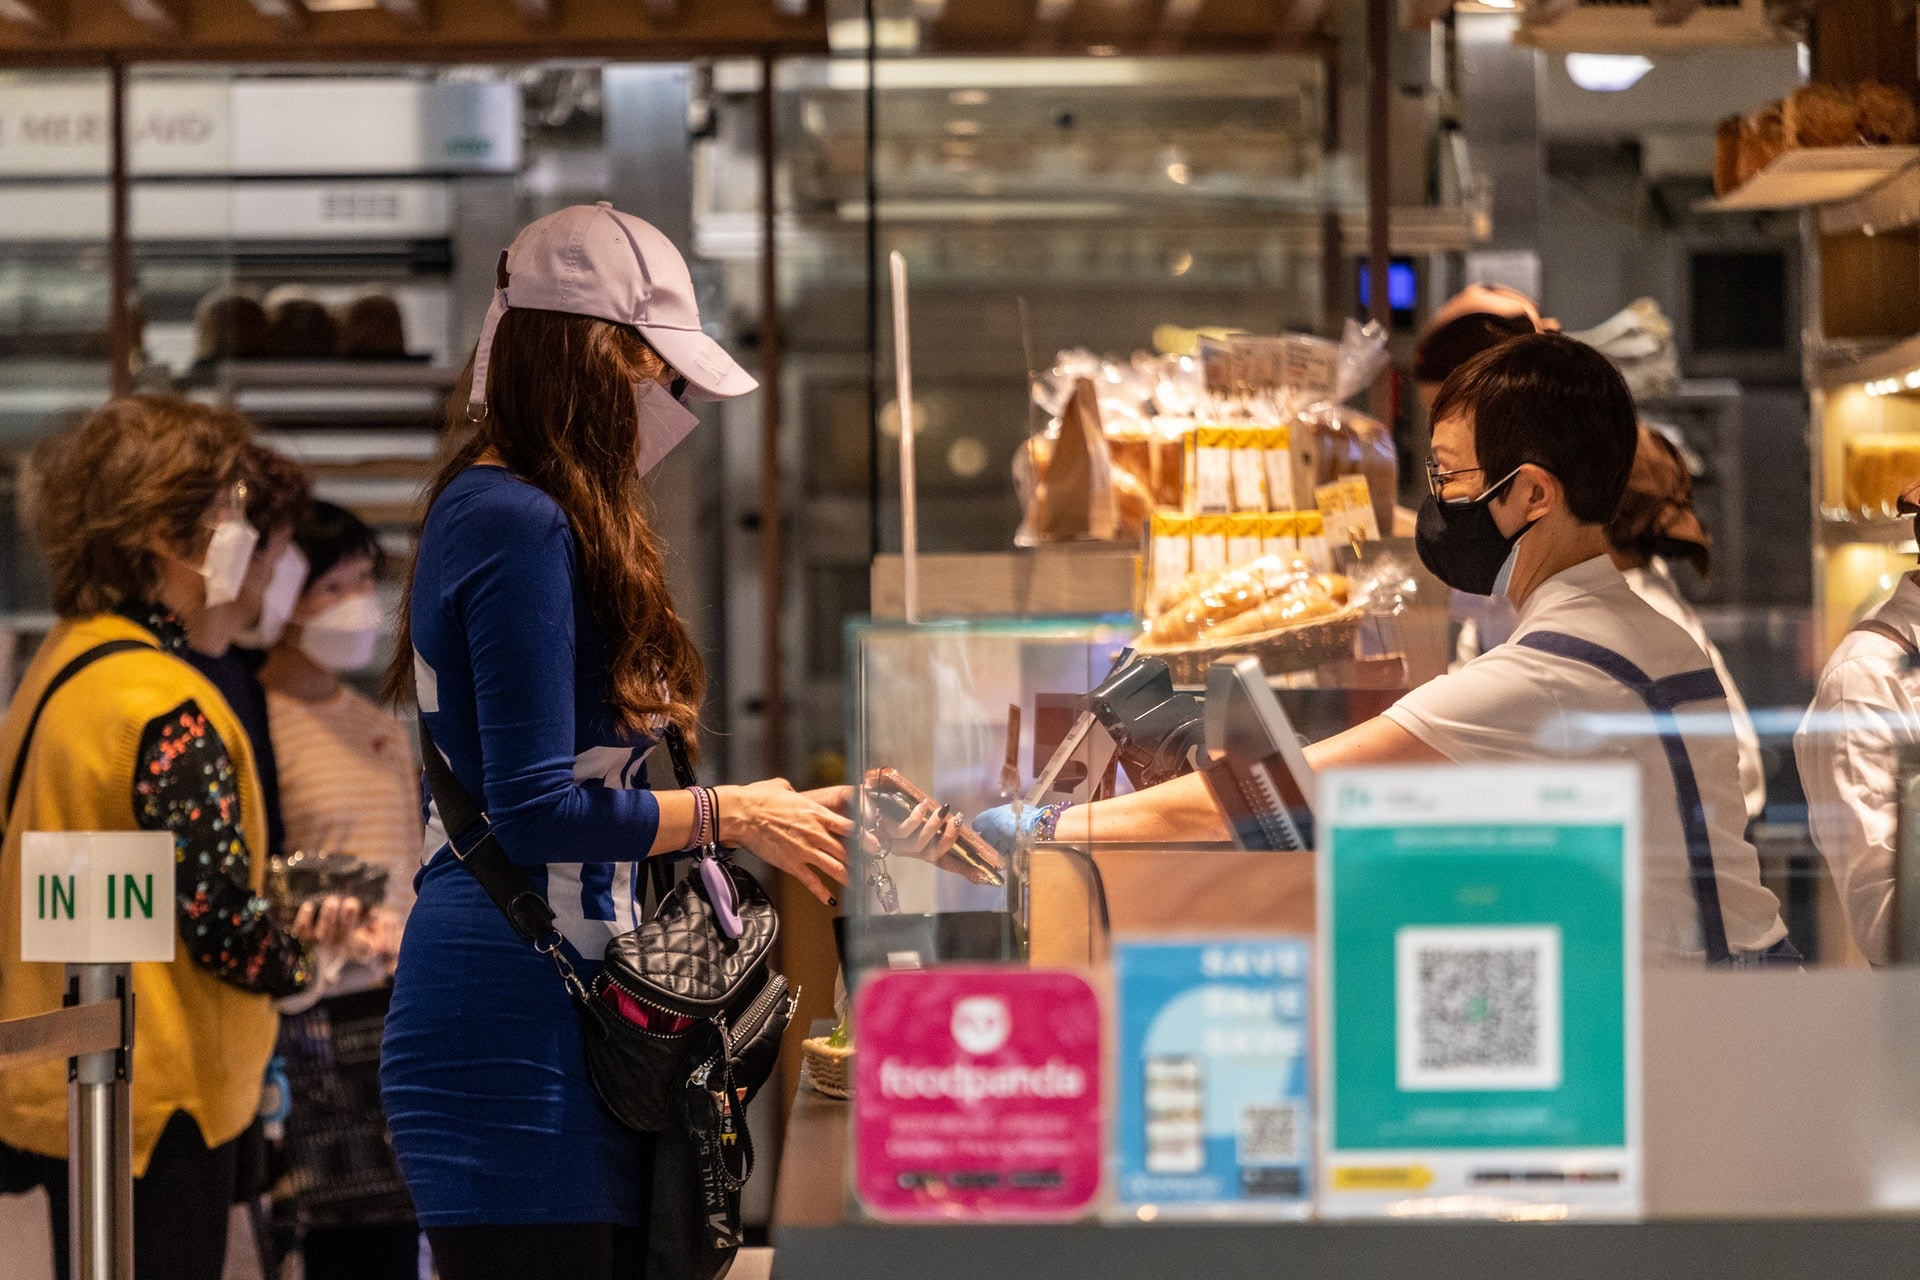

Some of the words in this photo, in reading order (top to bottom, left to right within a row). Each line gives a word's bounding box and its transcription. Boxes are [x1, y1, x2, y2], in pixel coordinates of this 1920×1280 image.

[22, 112, 215, 146] MERAID
[38, 874, 76, 921] IN
[107, 873, 154, 920] IN
[880, 1057, 1086, 1107] foodpanda
[702, 1163, 716, 1207] WILL
